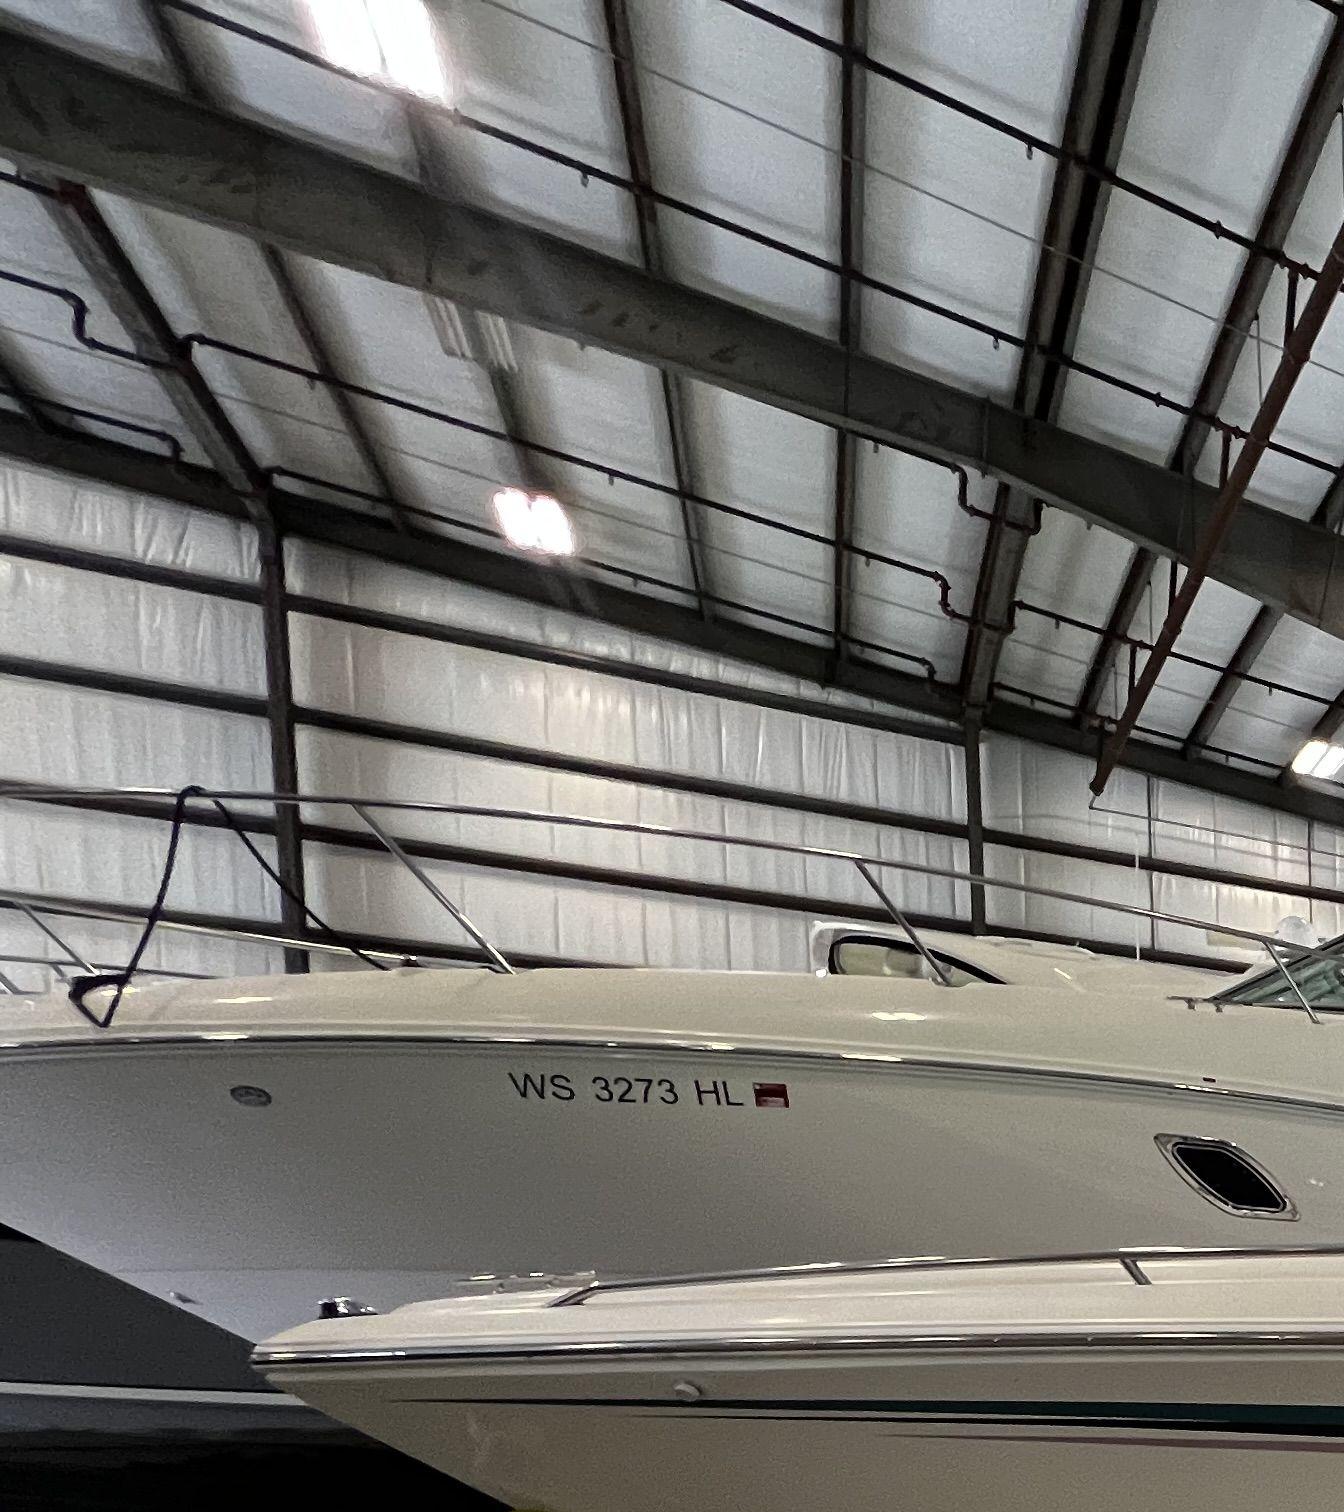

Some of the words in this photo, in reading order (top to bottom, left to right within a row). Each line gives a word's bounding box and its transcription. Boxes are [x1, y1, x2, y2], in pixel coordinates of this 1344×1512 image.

[508, 1072, 576, 1101] WS
[592, 1076, 679, 1105] 3273
[694, 1079, 744, 1106] HL
